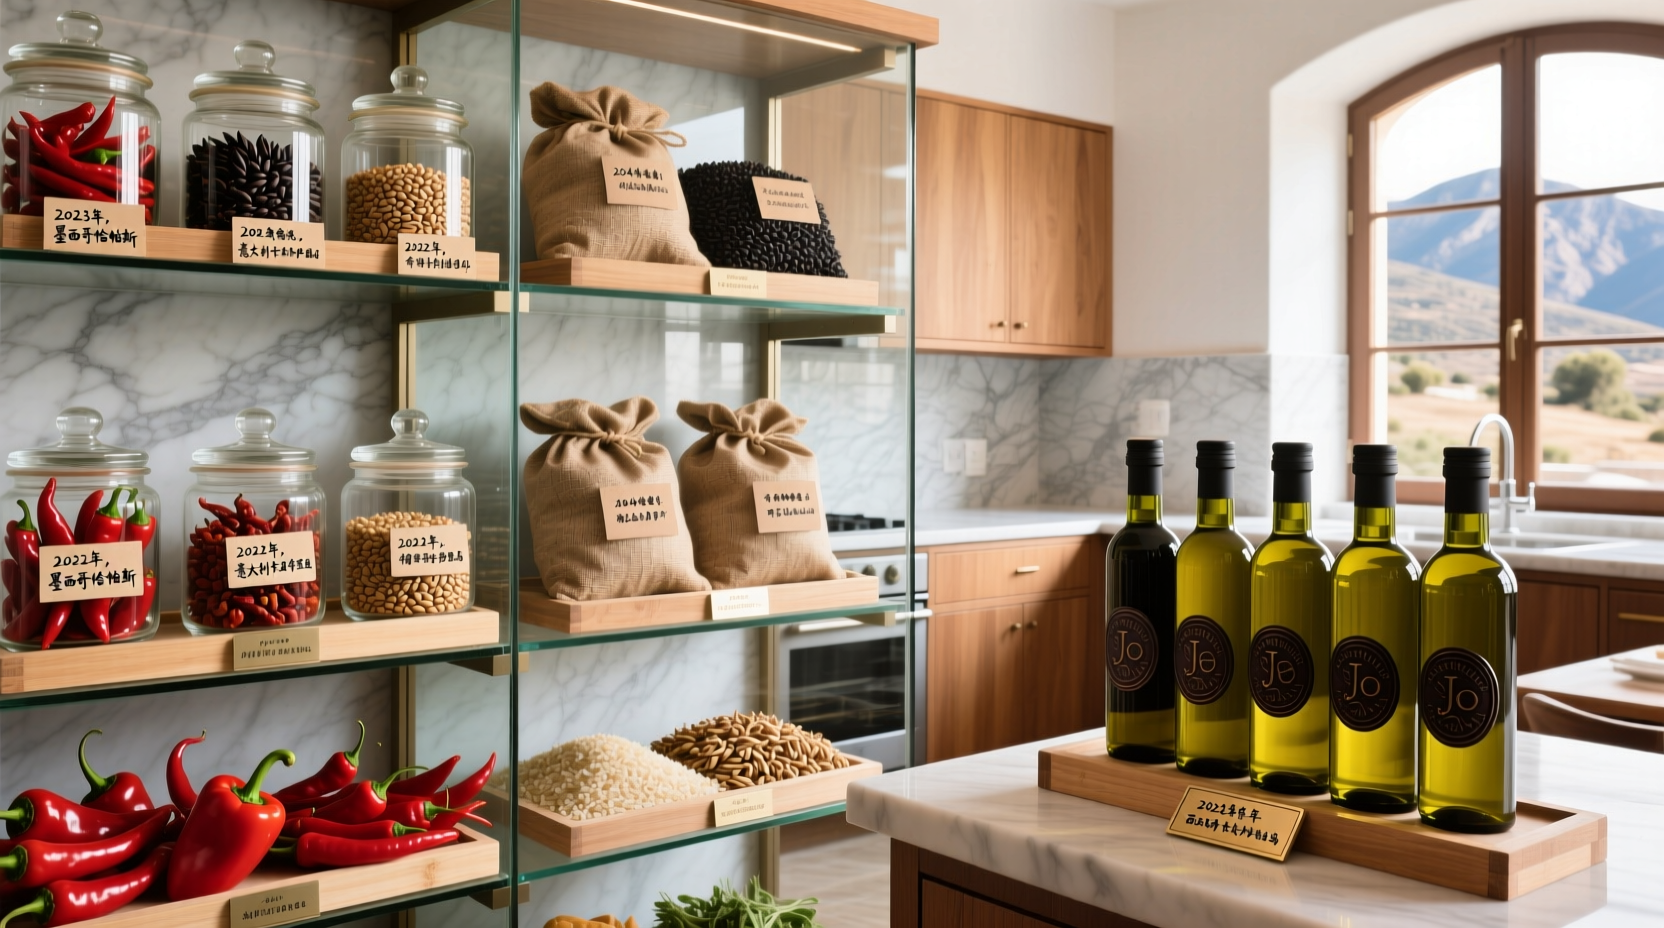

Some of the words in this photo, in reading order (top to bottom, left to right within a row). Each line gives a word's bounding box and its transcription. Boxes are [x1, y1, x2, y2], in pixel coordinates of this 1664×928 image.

[53, 224, 138, 248] 墨西哥恰帕斯
[48, 568, 137, 592] 墨西哥恰帕斯
[1343, 662, 1381, 701] Jo
[1437, 675, 1479, 716] Jo
